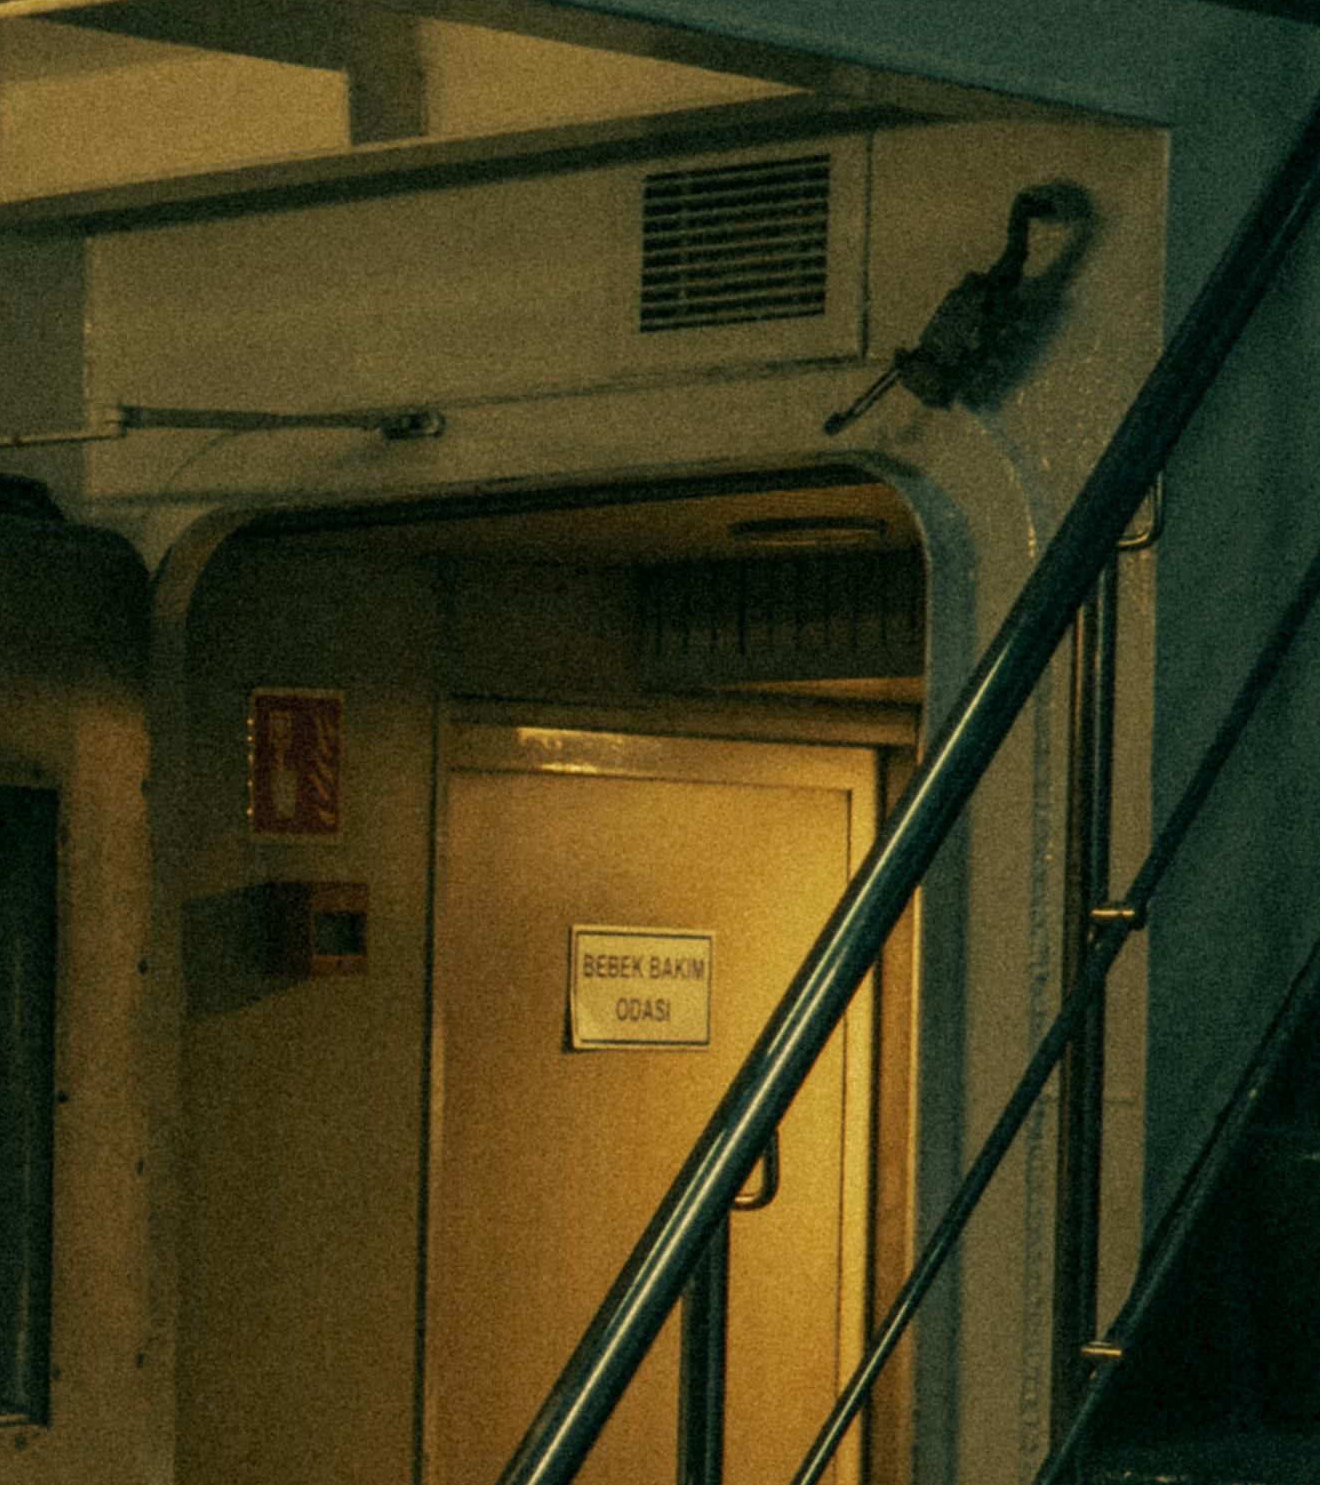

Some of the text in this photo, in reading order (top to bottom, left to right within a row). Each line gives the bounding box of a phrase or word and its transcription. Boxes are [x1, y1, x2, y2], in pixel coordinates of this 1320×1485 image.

[583, 953, 705, 980] BEBEK BAKIM
[615, 996, 671, 1022] ODASI
